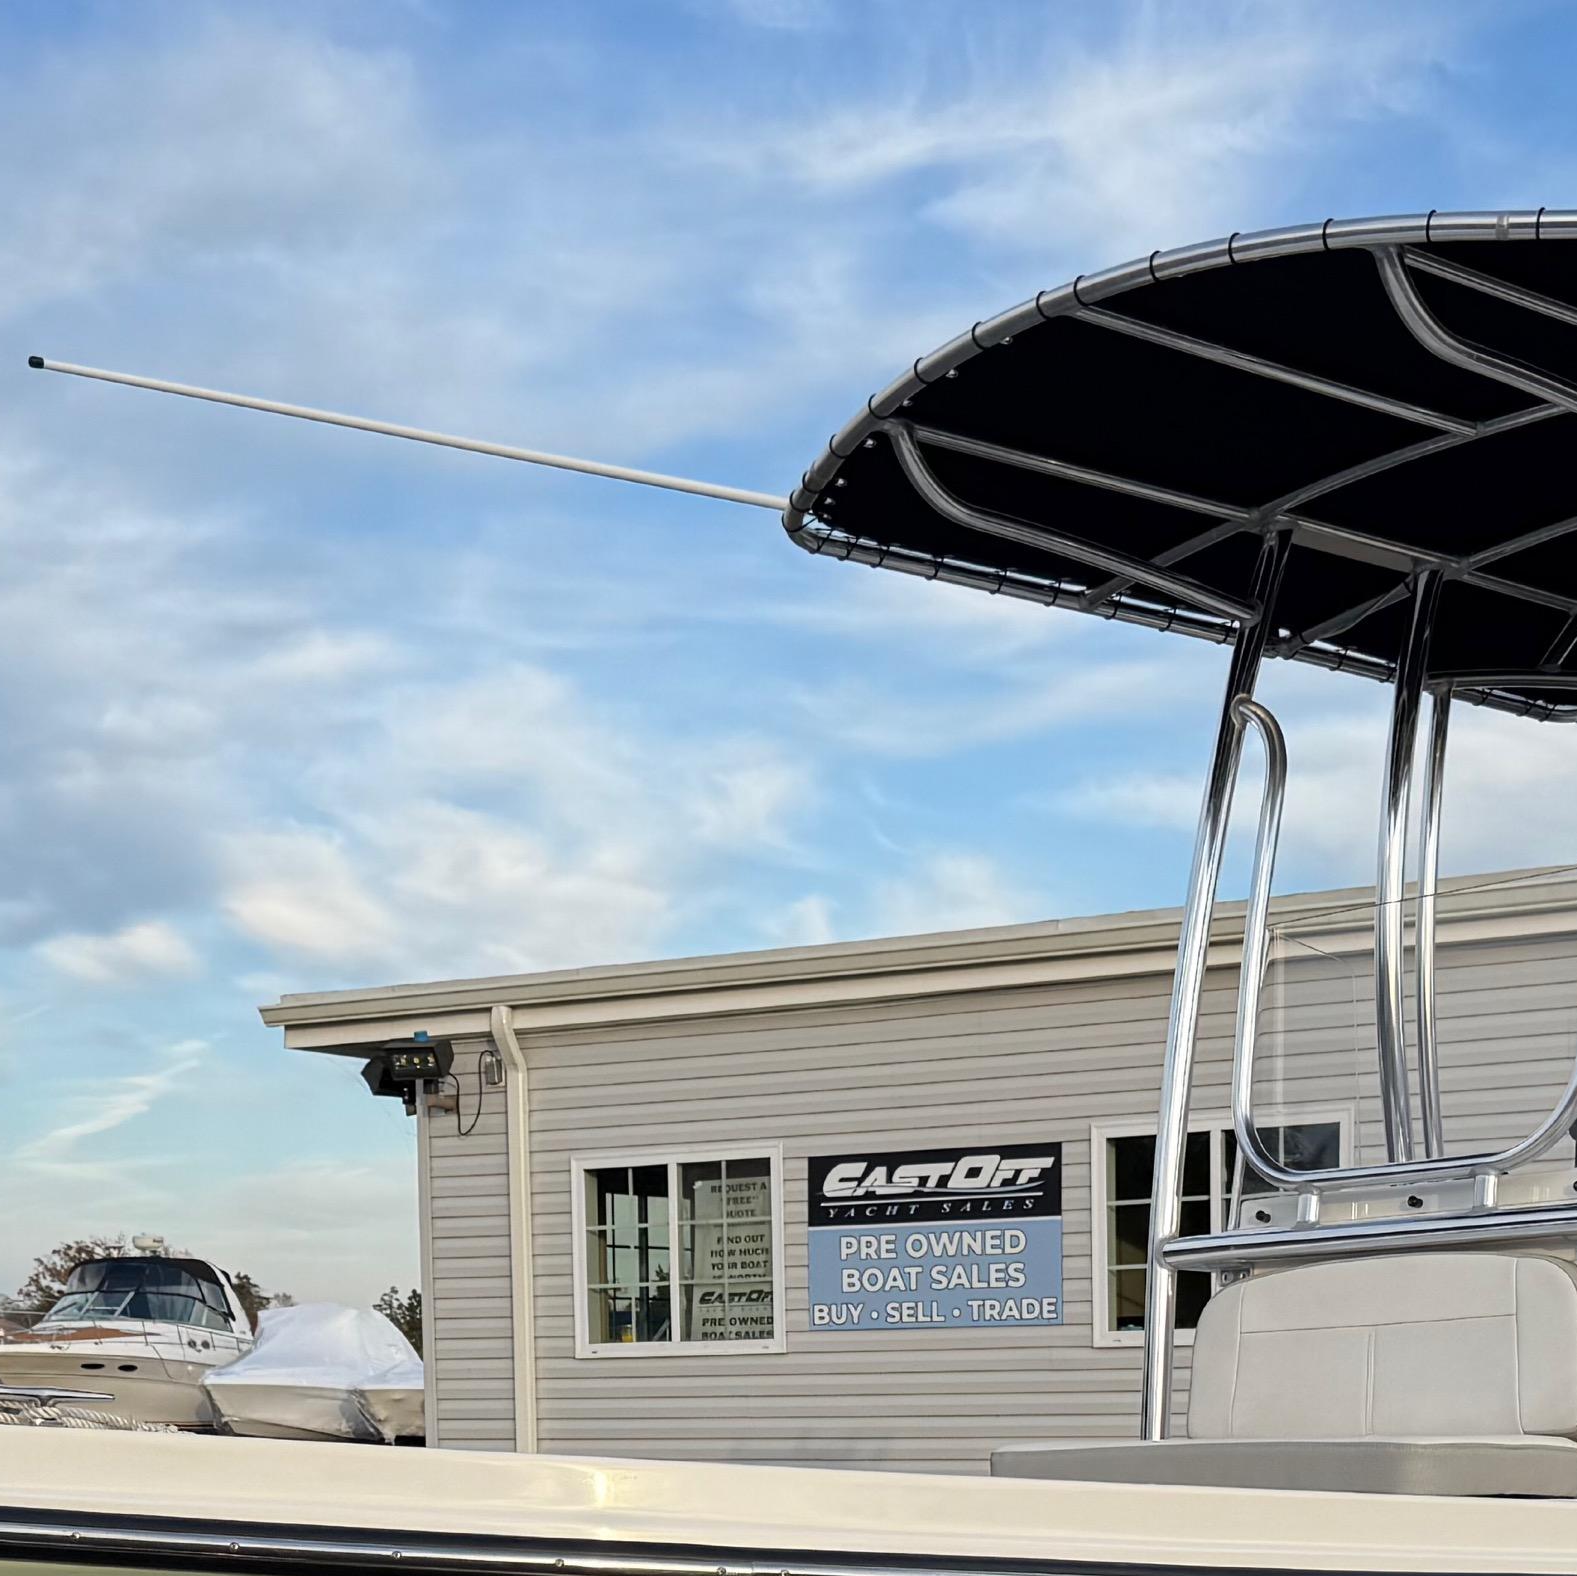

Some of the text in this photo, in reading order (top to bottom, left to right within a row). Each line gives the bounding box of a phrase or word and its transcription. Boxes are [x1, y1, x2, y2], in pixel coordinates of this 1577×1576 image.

[760, 1181, 767, 1190] A
[726, 1209, 755, 1218] UOTE
[827, 1198, 1035, 1219] YACHT SALES
[717, 1234, 765, 1245] FND OUT
[839, 1229, 1027, 1261] PRE OWNED
[739, 1247, 769, 1256] MUCH
[740, 1260, 769, 1270] BOAT
[841, 1262, 1026, 1293] BOAT SALES
[812, 1297, 1058, 1326] BUY SELL TRADE
[702, 1316, 774, 1327] PRE OWNED
[734, 1330, 774, 1339] SALES
